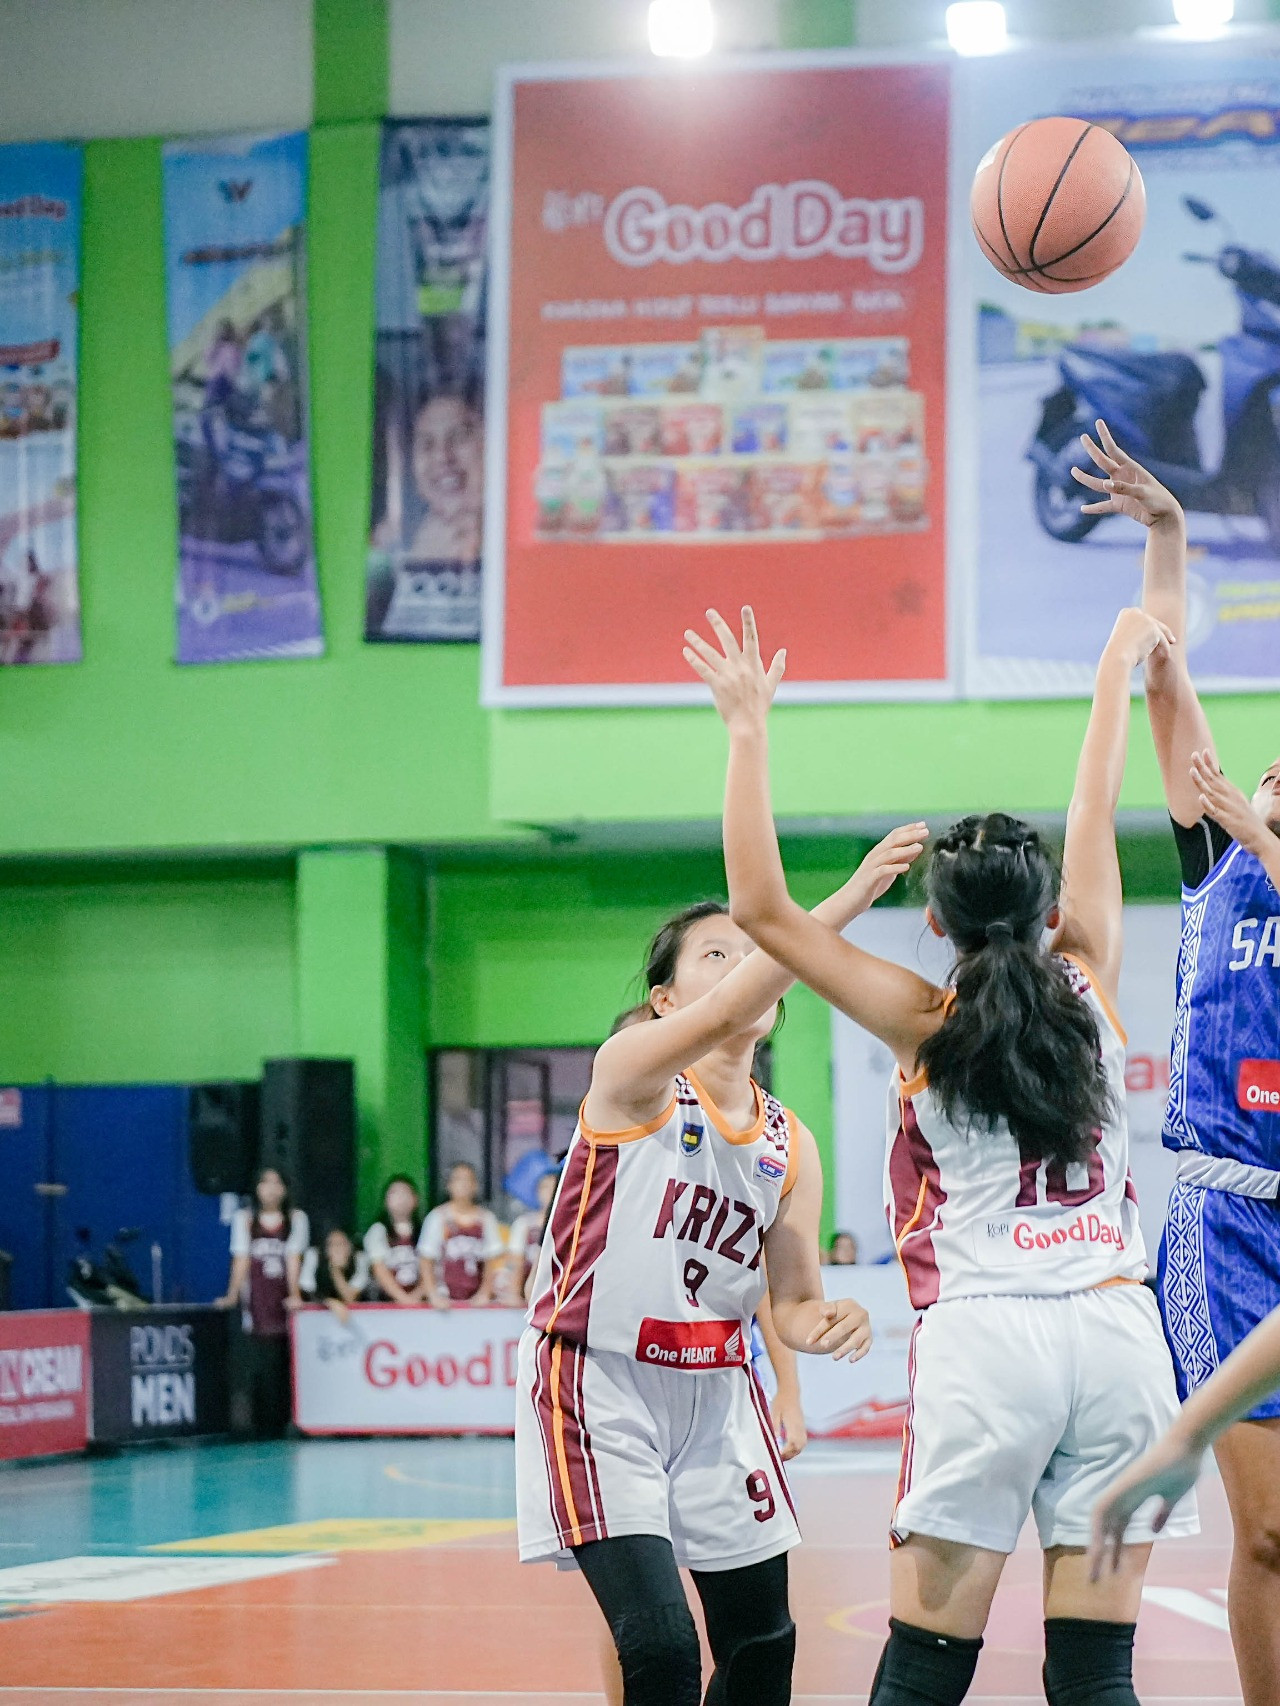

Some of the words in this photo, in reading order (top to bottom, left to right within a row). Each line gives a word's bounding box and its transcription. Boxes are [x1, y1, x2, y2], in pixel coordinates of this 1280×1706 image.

[1246, 1085, 1280, 1104] One
[683, 1258, 709, 1308] 9
[645, 1343, 677, 1362] One
[131, 1372, 196, 1428] MEN
[746, 1469, 776, 1523] 9
